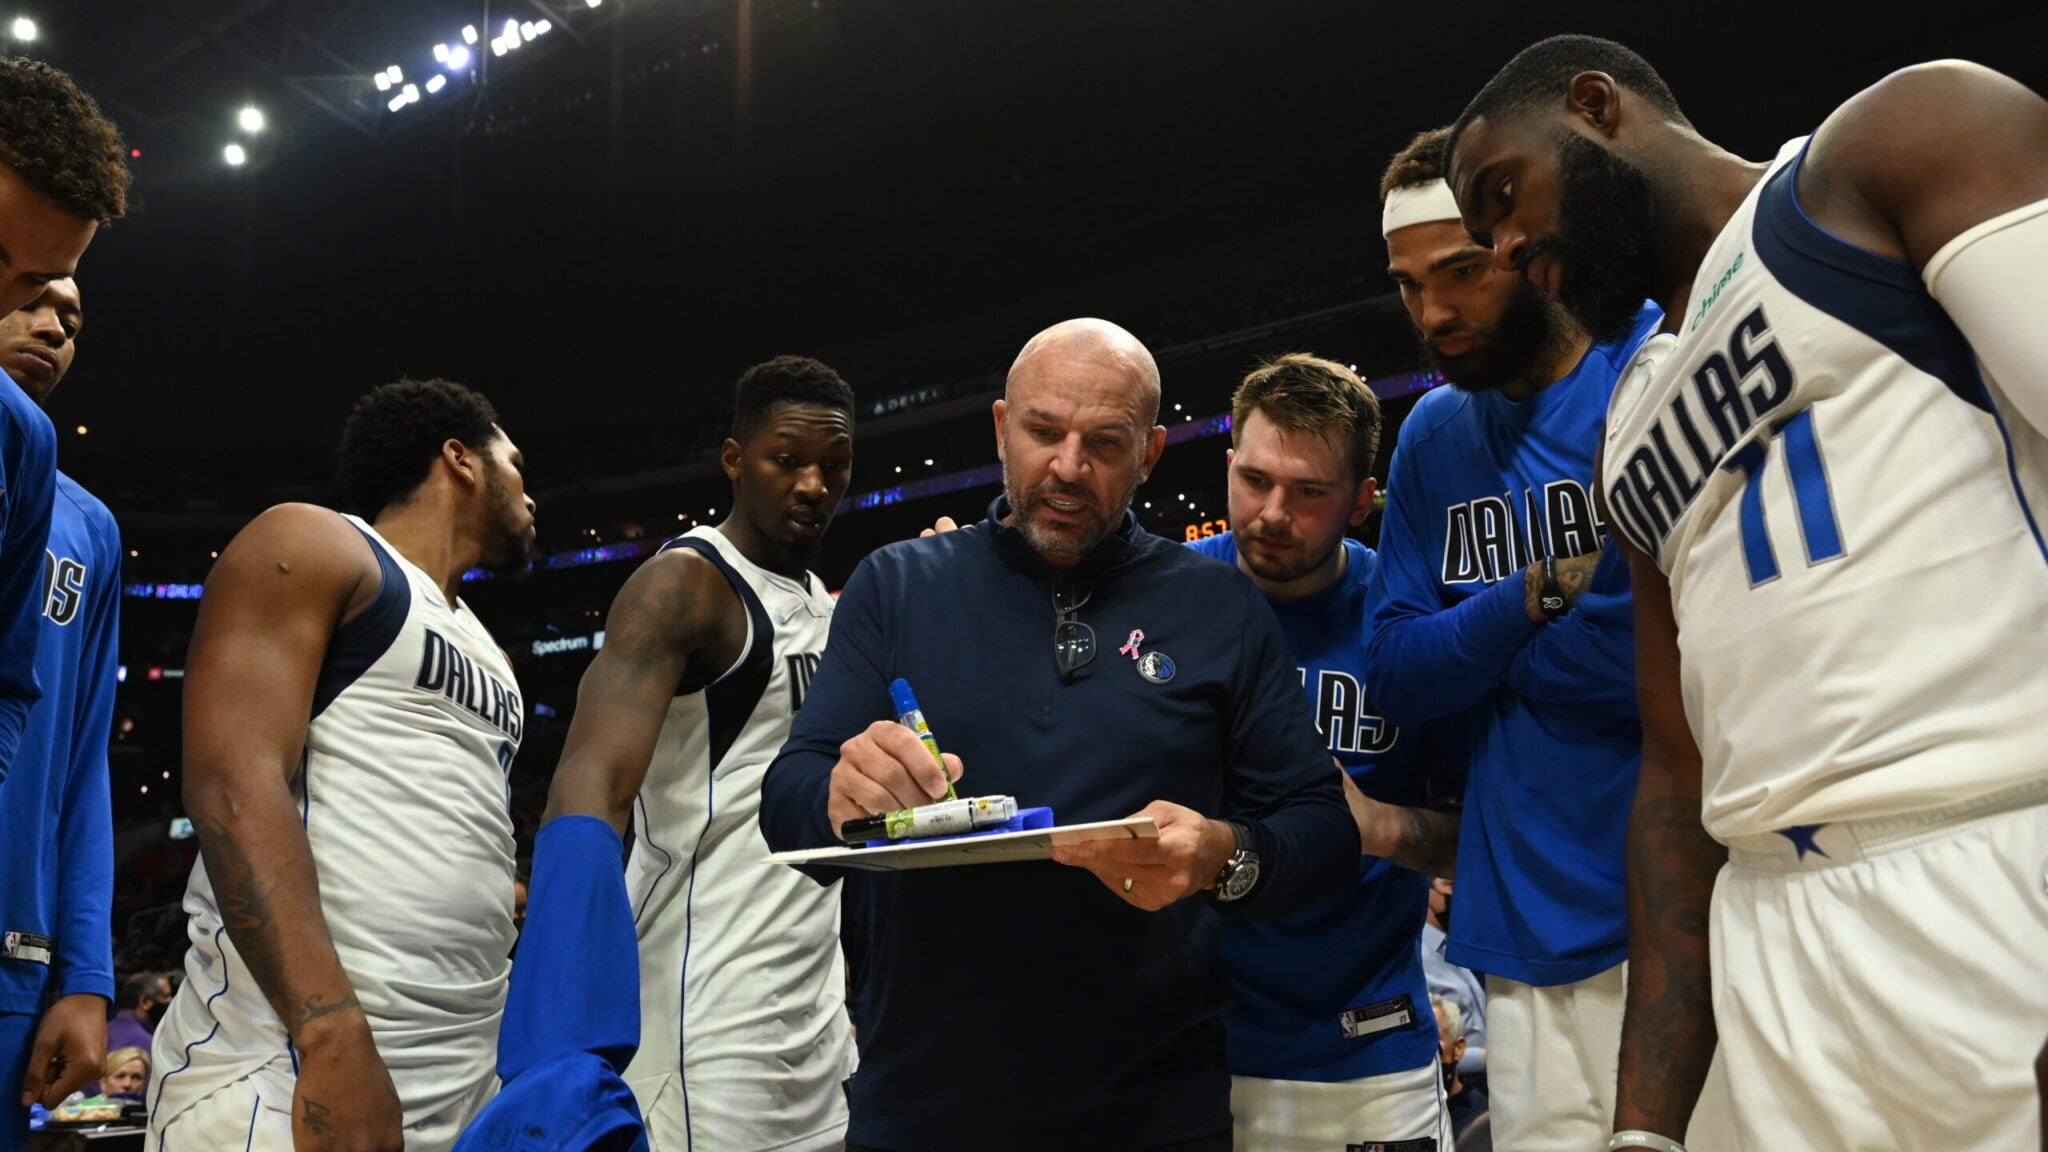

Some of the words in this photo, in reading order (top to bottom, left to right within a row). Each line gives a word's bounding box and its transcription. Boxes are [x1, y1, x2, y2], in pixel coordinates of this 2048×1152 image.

[1691, 251, 1745, 333] chime
[1609, 302, 1798, 566] DALLAS
[1720, 403, 1848, 592] 11
[413, 624, 523, 748] DALLAS
[531, 636, 589, 657] Spectrum
